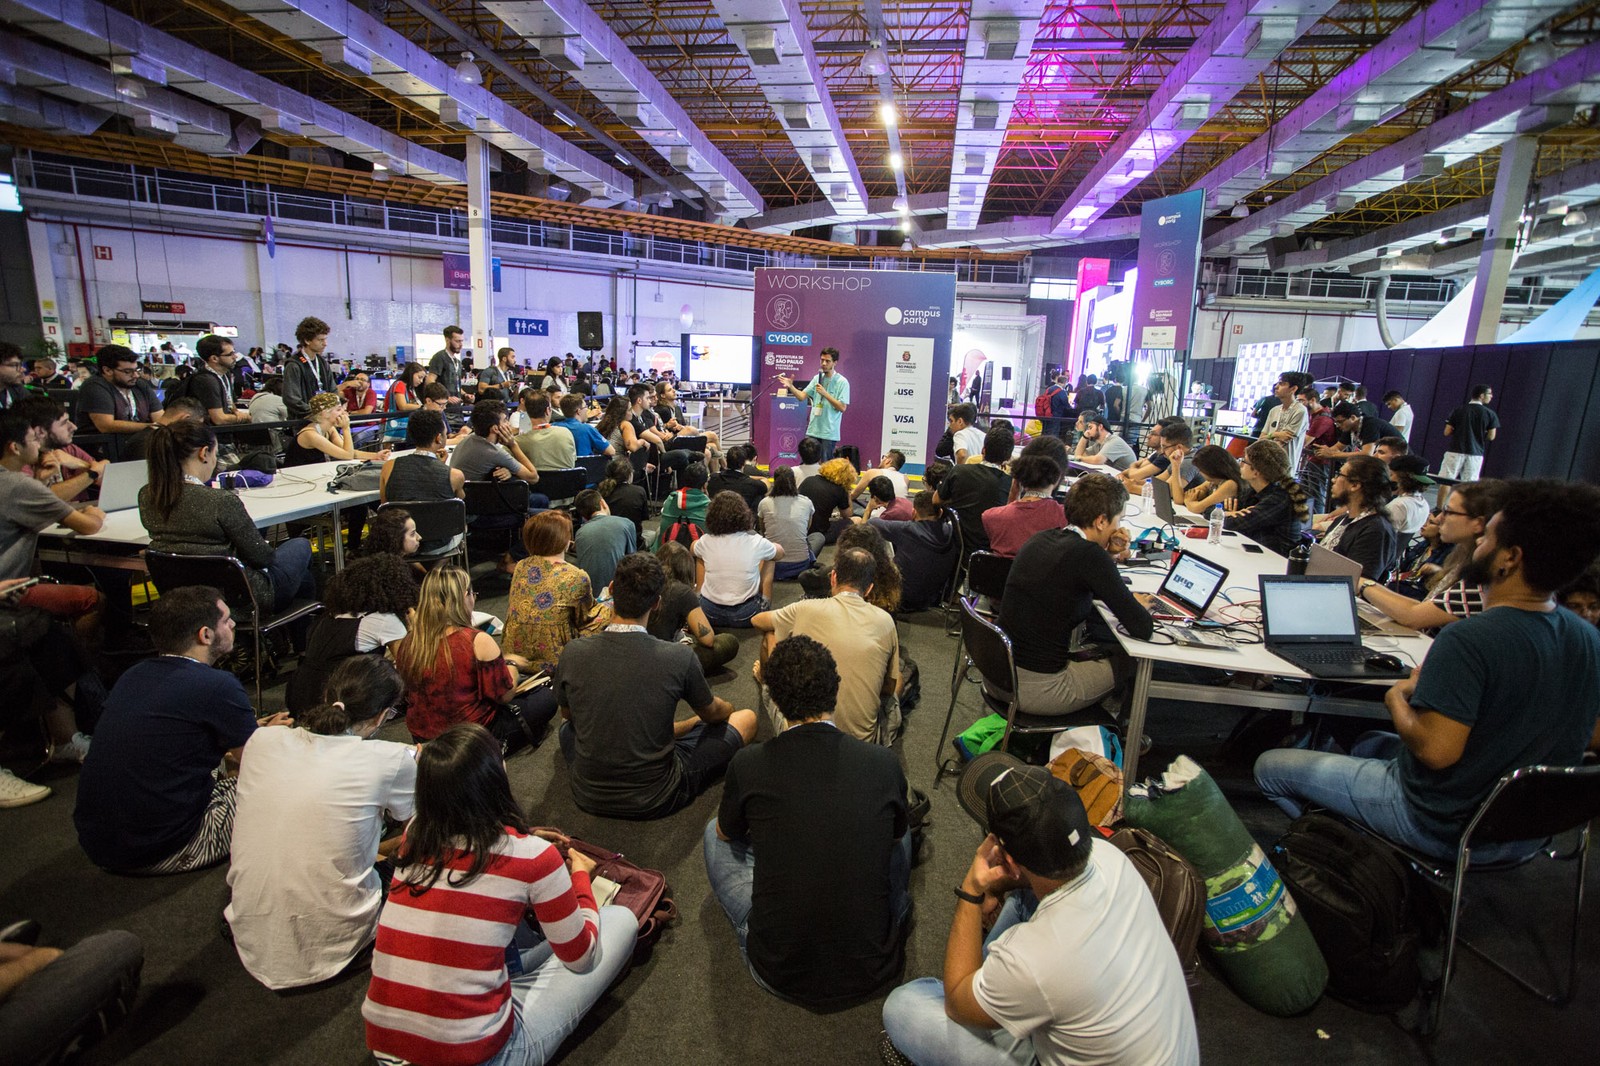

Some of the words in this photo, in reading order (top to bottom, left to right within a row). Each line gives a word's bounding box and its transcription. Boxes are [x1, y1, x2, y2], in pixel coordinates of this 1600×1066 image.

[473, 209, 478, 217] 8
[767, 275, 872, 291] WORKSHOP
[903, 310, 941, 319] campus
[902, 317, 928, 326] party
[768, 334, 808, 344] CYBORG
[894, 414, 915, 424] VISA
